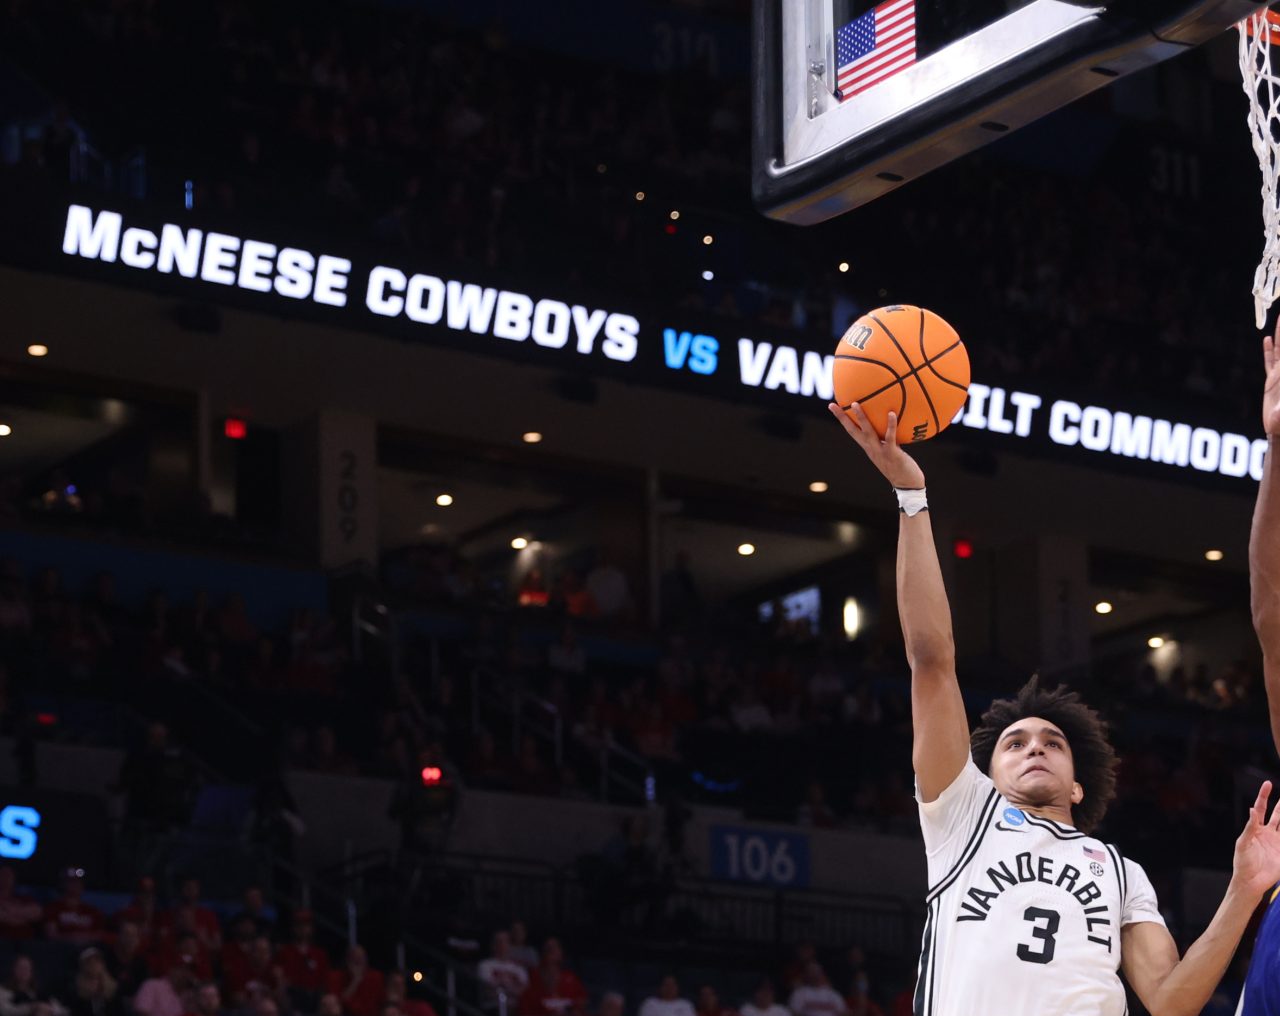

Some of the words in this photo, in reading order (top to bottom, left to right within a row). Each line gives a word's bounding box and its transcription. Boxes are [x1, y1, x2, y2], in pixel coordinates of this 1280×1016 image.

[63, 204, 351, 306] McNEESE
[366, 266, 639, 361] COWBOYS
[664, 328, 719, 375] VS
[738, 339, 1042, 437] VANILT
[724, 832, 796, 883] 106
[957, 851, 1112, 954] VANDERBILT
[1016, 906, 1061, 965] 3
